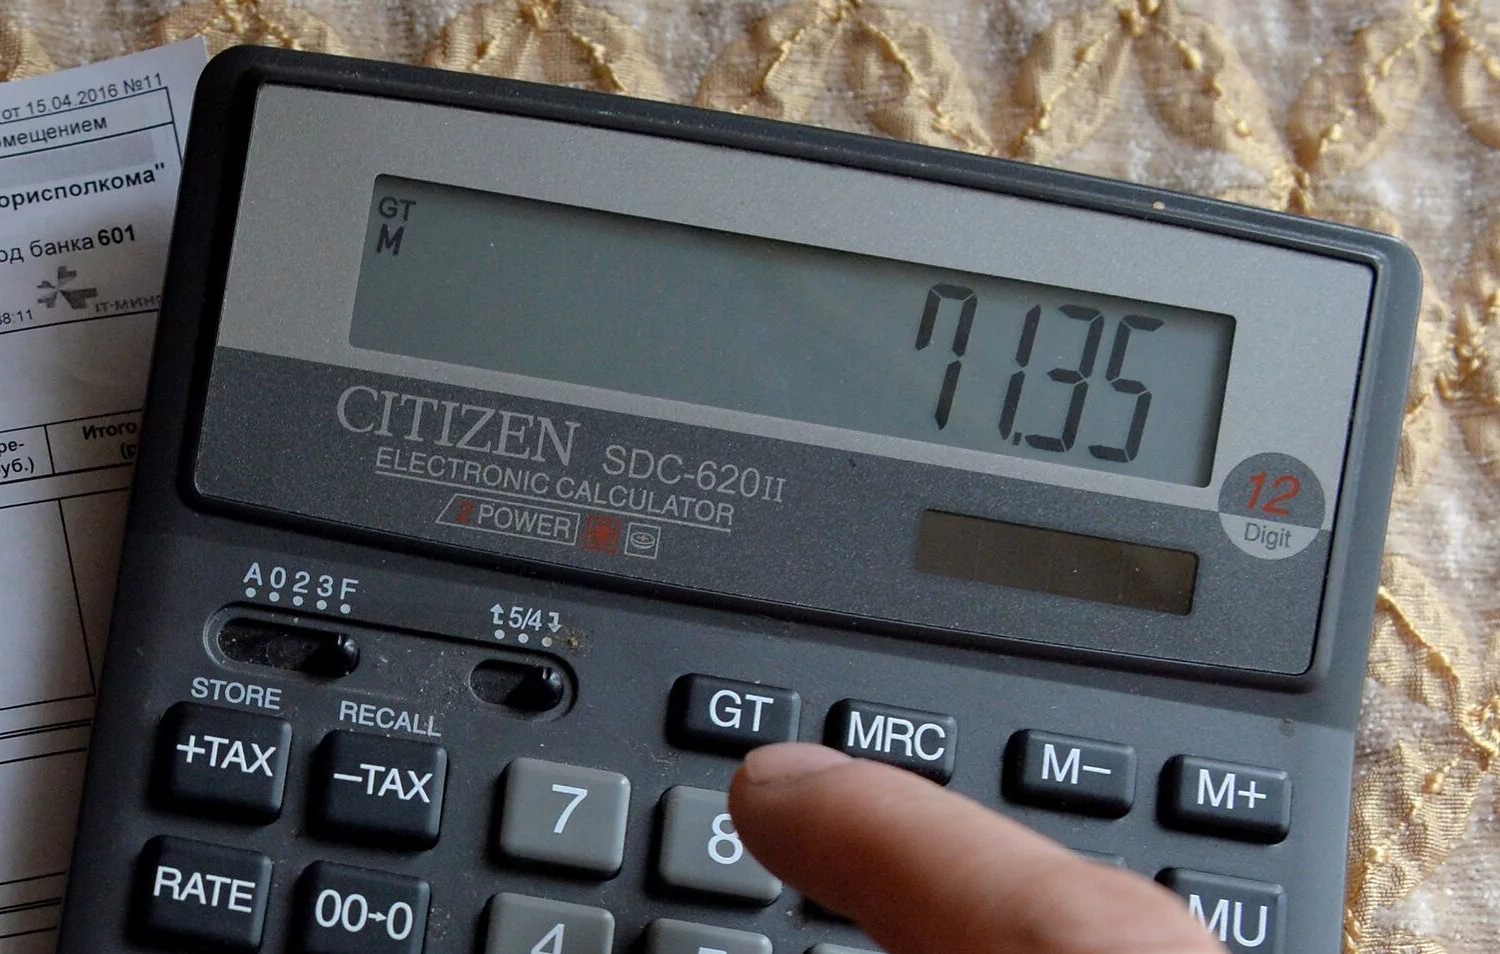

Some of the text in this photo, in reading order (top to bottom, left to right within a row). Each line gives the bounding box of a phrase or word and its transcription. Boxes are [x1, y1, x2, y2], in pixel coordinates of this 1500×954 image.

[27, 84, 118, 116] 15.04.2016
[124, 73, 162, 94] №11
[379, 196, 417, 221] GT
[30, 235, 94, 259] банка
[97, 225, 137, 247] 601
[376, 225, 405, 255] M
[914, 283, 1164, 464] 71.35
[337, 385, 580, 466] CITIZEN
[376, 446, 734, 525] ELECTRONIC CALCULATOR
[1246, 471, 1299, 516] 12
[477, 505, 571, 540] POWER
[1244, 523, 1291, 549] Digit
[191, 678, 282, 709] STORE
[709, 690, 774, 732] GT
[339, 701, 442, 736] RECALL
[847, 712, 945, 761] MRC
[177, 735, 276, 777] +TAX
[552, 784, 588, 833] 7
[1197, 769, 1267, 810] M+
[153, 866, 256, 913] RATE
